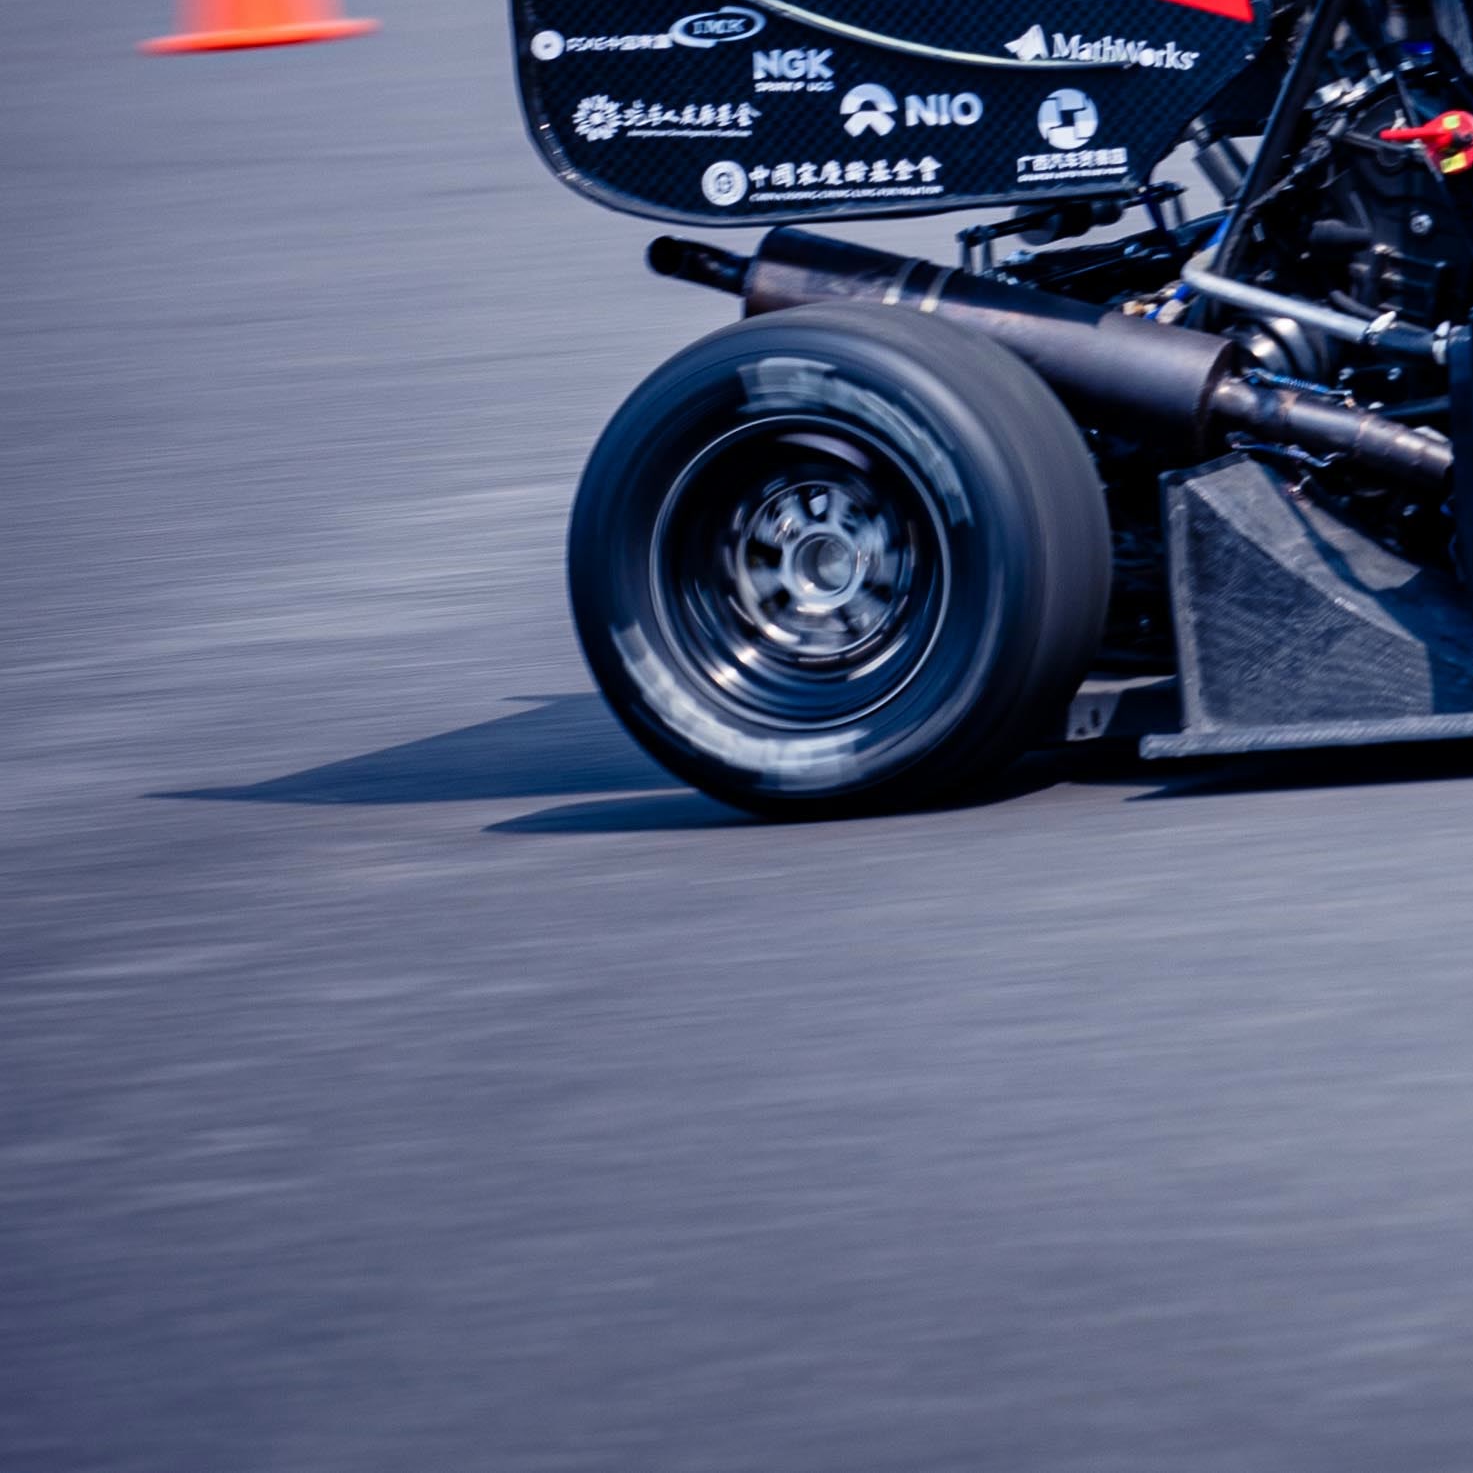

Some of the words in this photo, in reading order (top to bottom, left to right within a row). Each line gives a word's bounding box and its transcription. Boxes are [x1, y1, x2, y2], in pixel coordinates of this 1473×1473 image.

[752, 48, 835, 80] NGK
[1051, 32, 1197, 71] MathWorks
[904, 91, 984, 127] NIO
